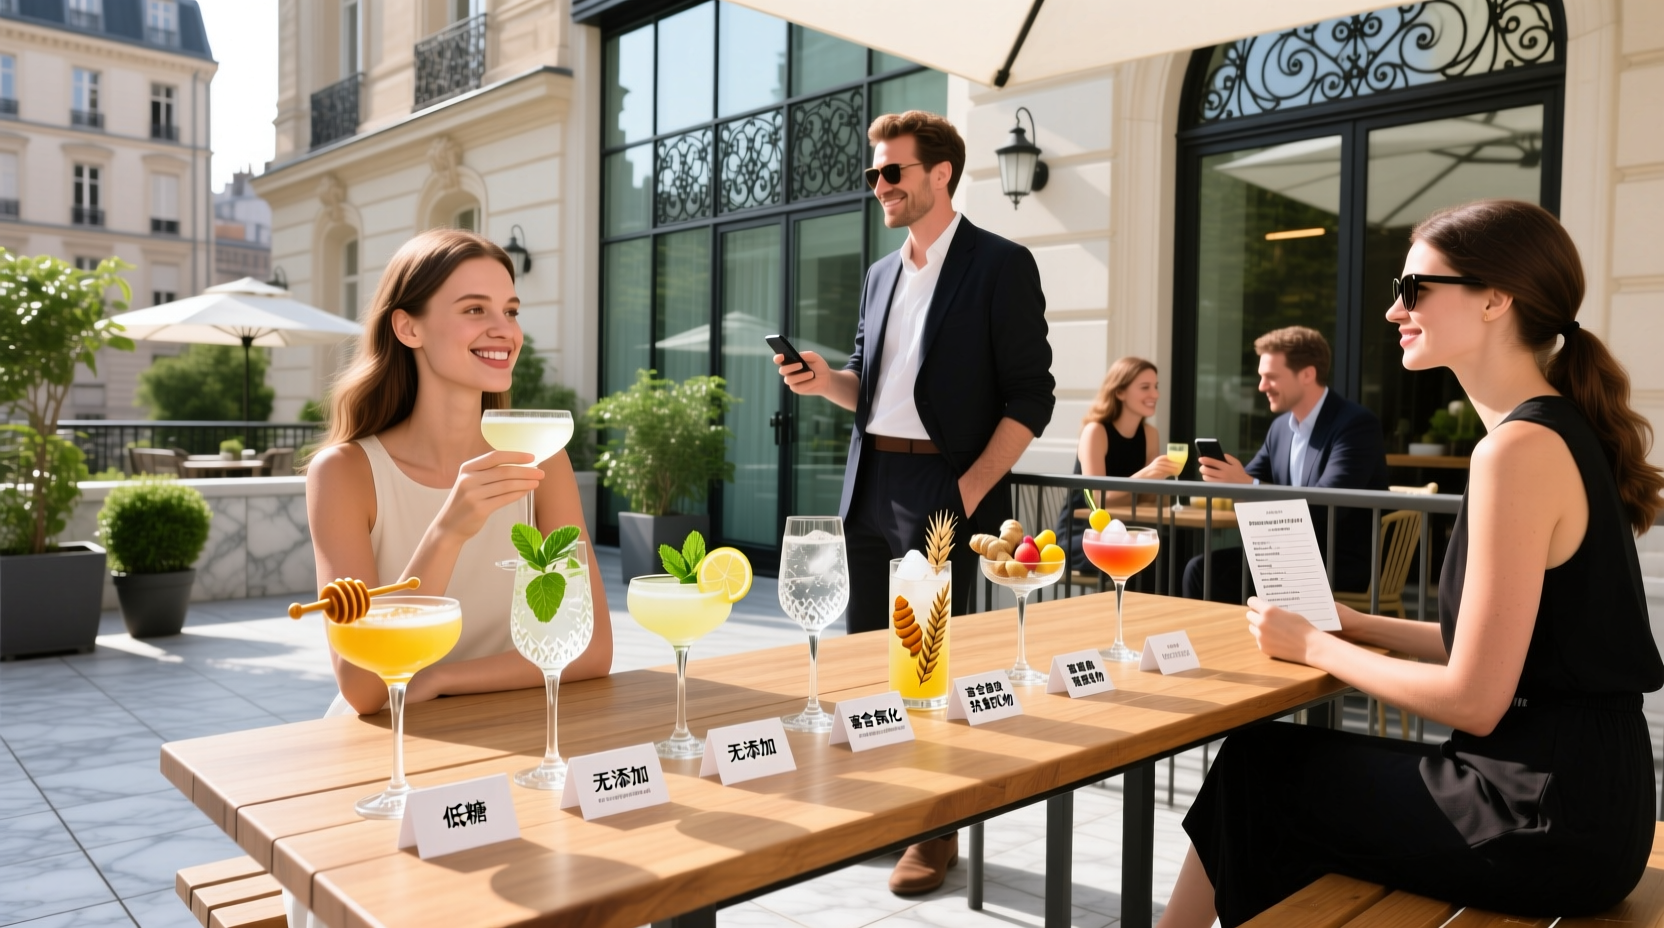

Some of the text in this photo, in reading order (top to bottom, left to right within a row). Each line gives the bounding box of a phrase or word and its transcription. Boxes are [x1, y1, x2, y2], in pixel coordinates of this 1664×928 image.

[728, 737, 777, 763] 无添加
[593, 765, 649, 793] 无添加
[442, 799, 487, 829] 低糖
